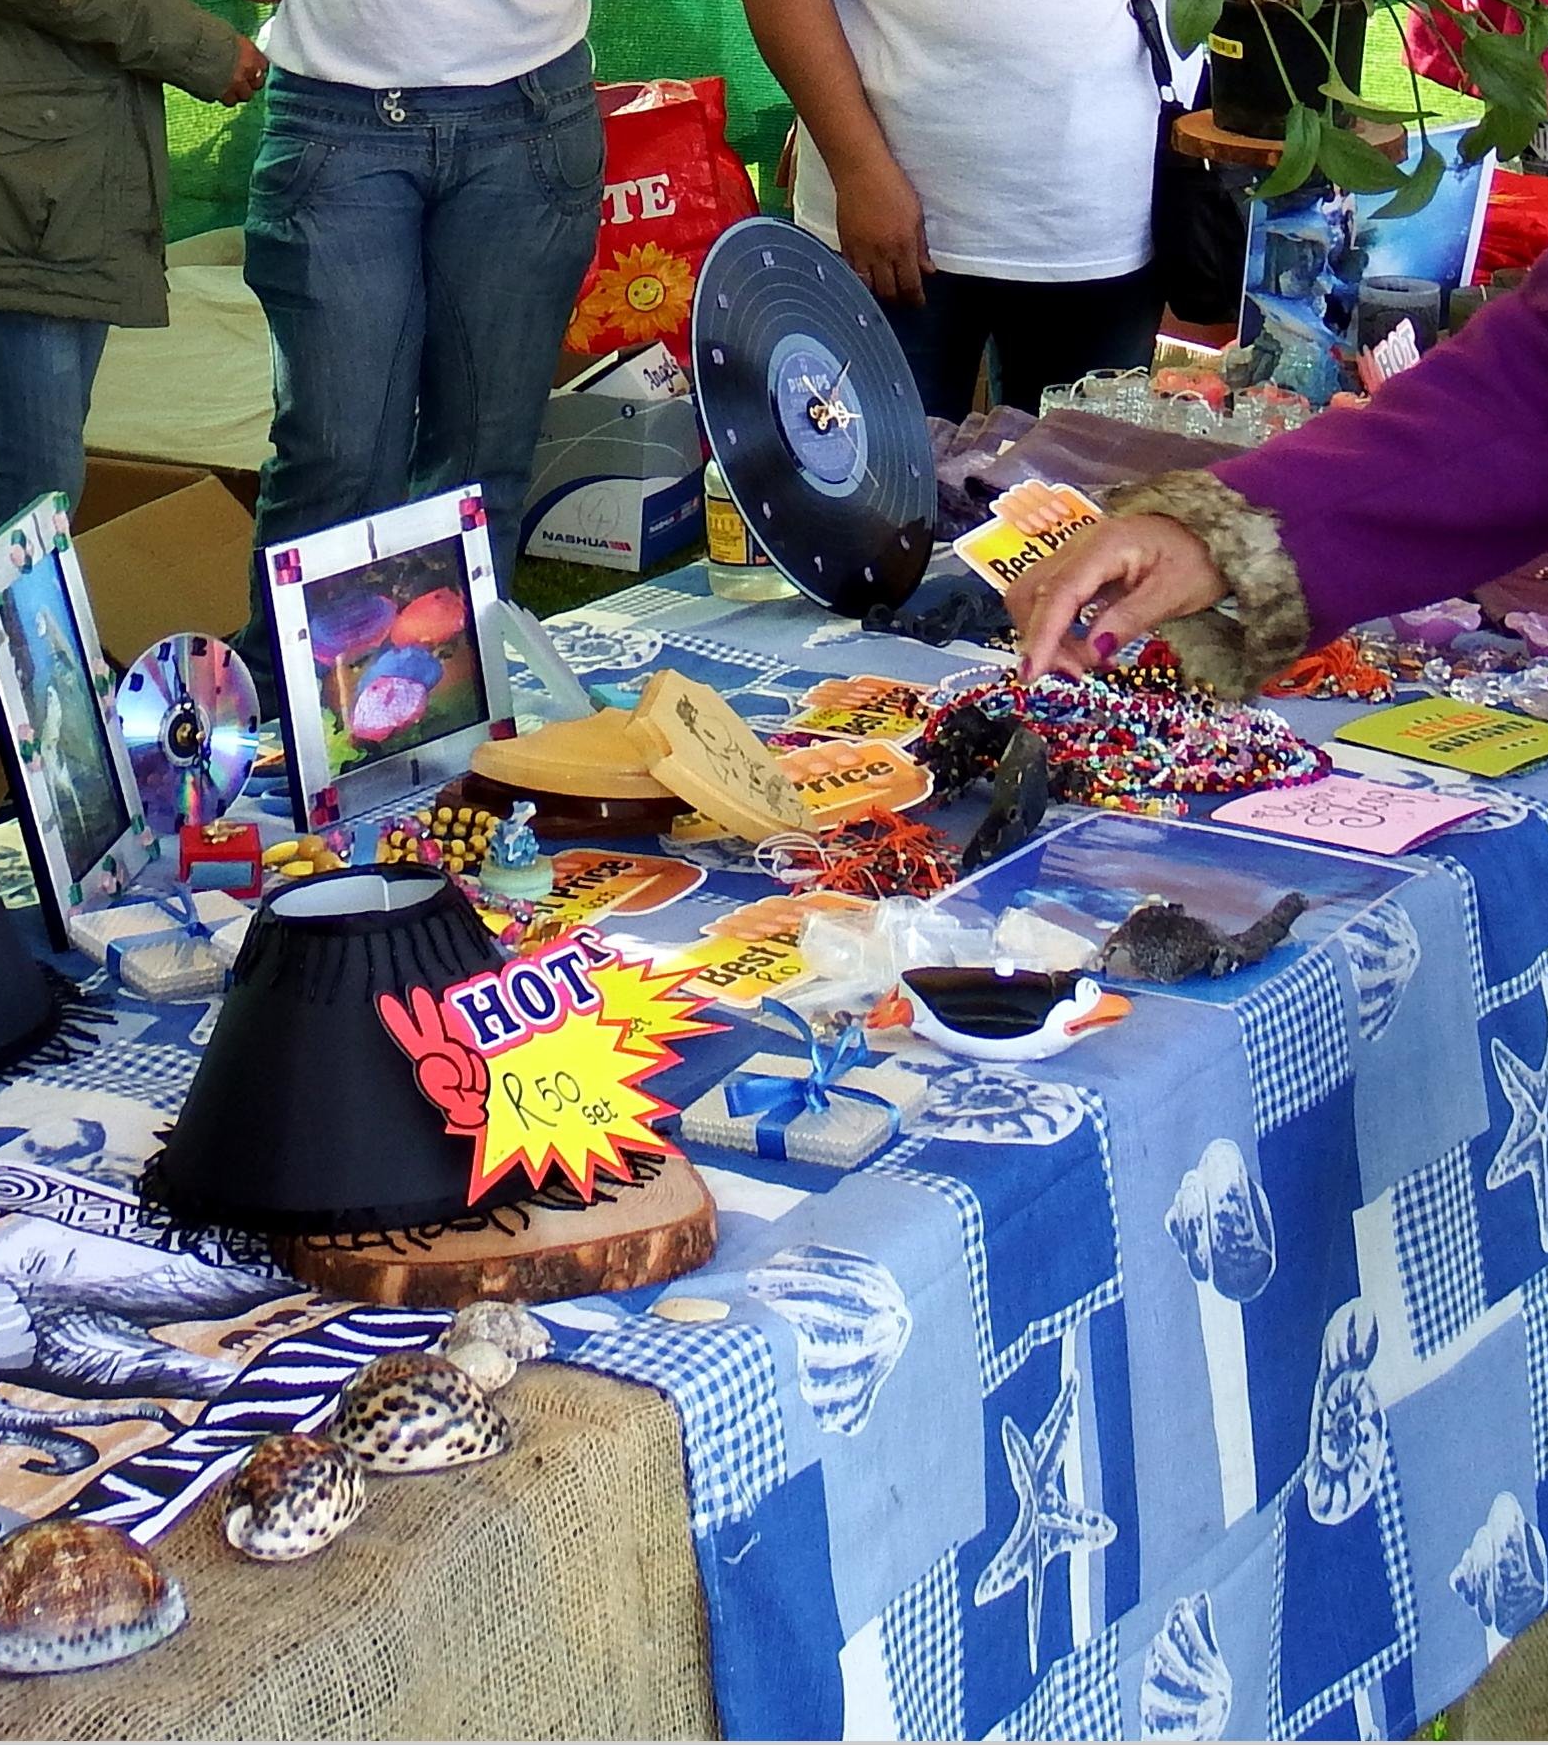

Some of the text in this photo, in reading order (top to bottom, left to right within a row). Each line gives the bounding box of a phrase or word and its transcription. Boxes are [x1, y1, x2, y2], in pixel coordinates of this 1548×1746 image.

[600, 173, 676, 226] TE
[1378, 328, 1417, 376] HOT
[542, 530, 609, 550] NASHUA
[792, 761, 894, 794] rice
[548, 860, 635, 900] Price
[696, 944, 790, 988] Best
[457, 951, 595, 1045] HOT
[502, 1070, 581, 1131] R50
[582, 1098, 619, 1126] set
